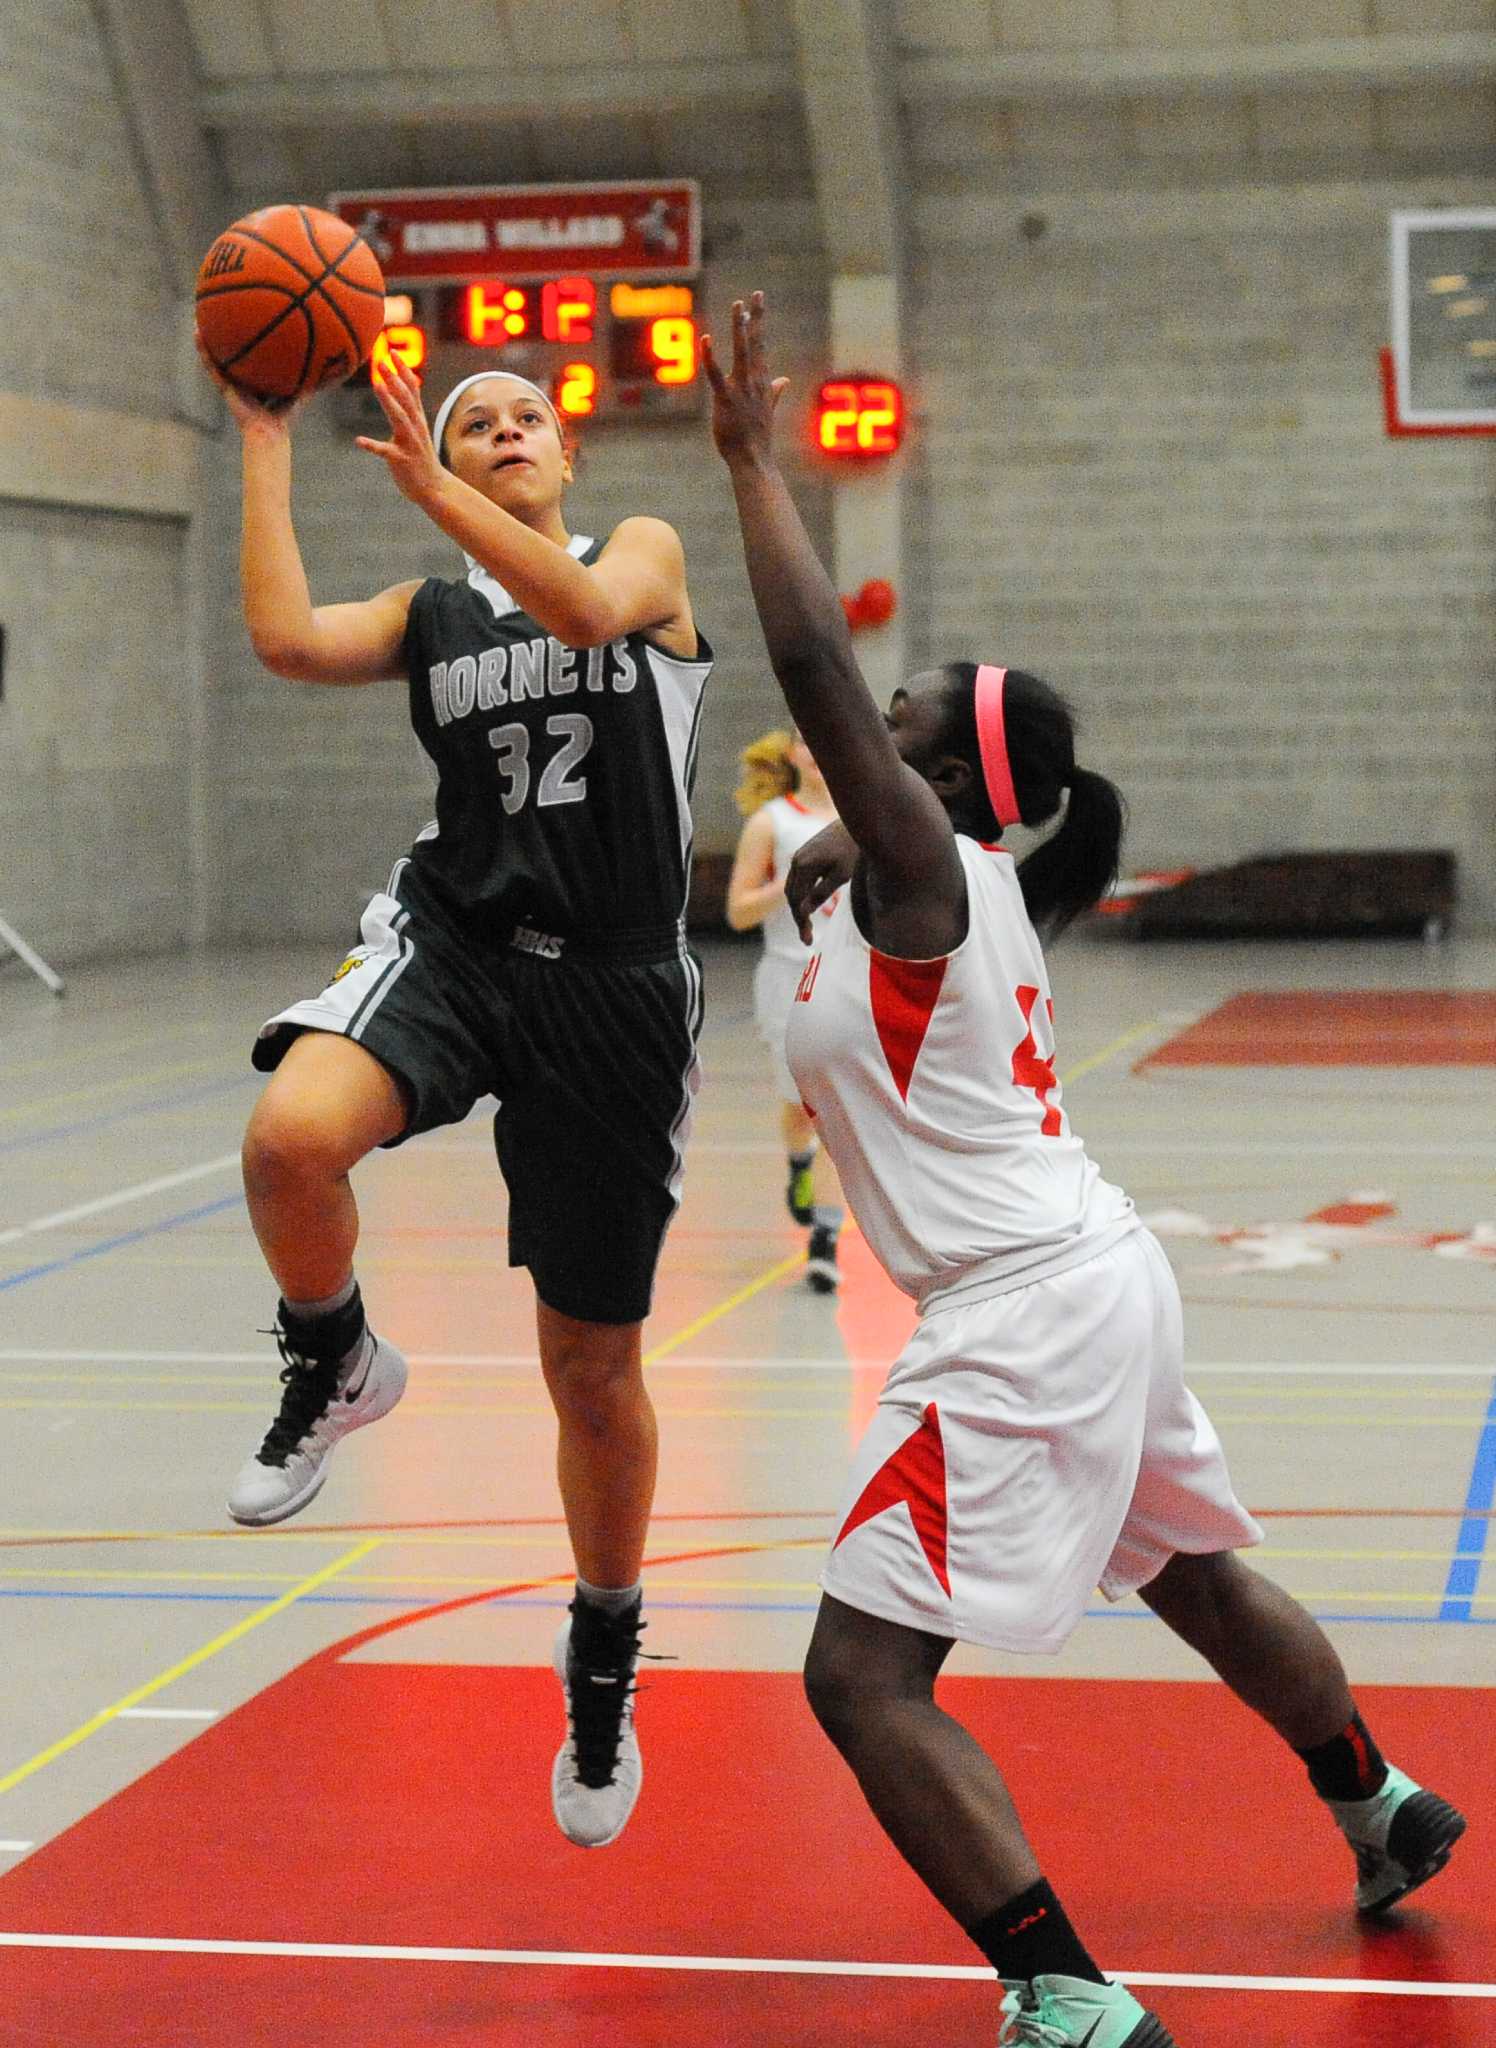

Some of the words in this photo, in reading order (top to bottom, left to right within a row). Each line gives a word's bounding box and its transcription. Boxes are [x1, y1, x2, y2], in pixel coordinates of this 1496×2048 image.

[651, 317, 694, 384] 9
[561, 363, 595, 414] 2
[821, 384, 896, 450] 22
[429, 635, 637, 726] HORNETS
[489, 713, 593, 815] 32
